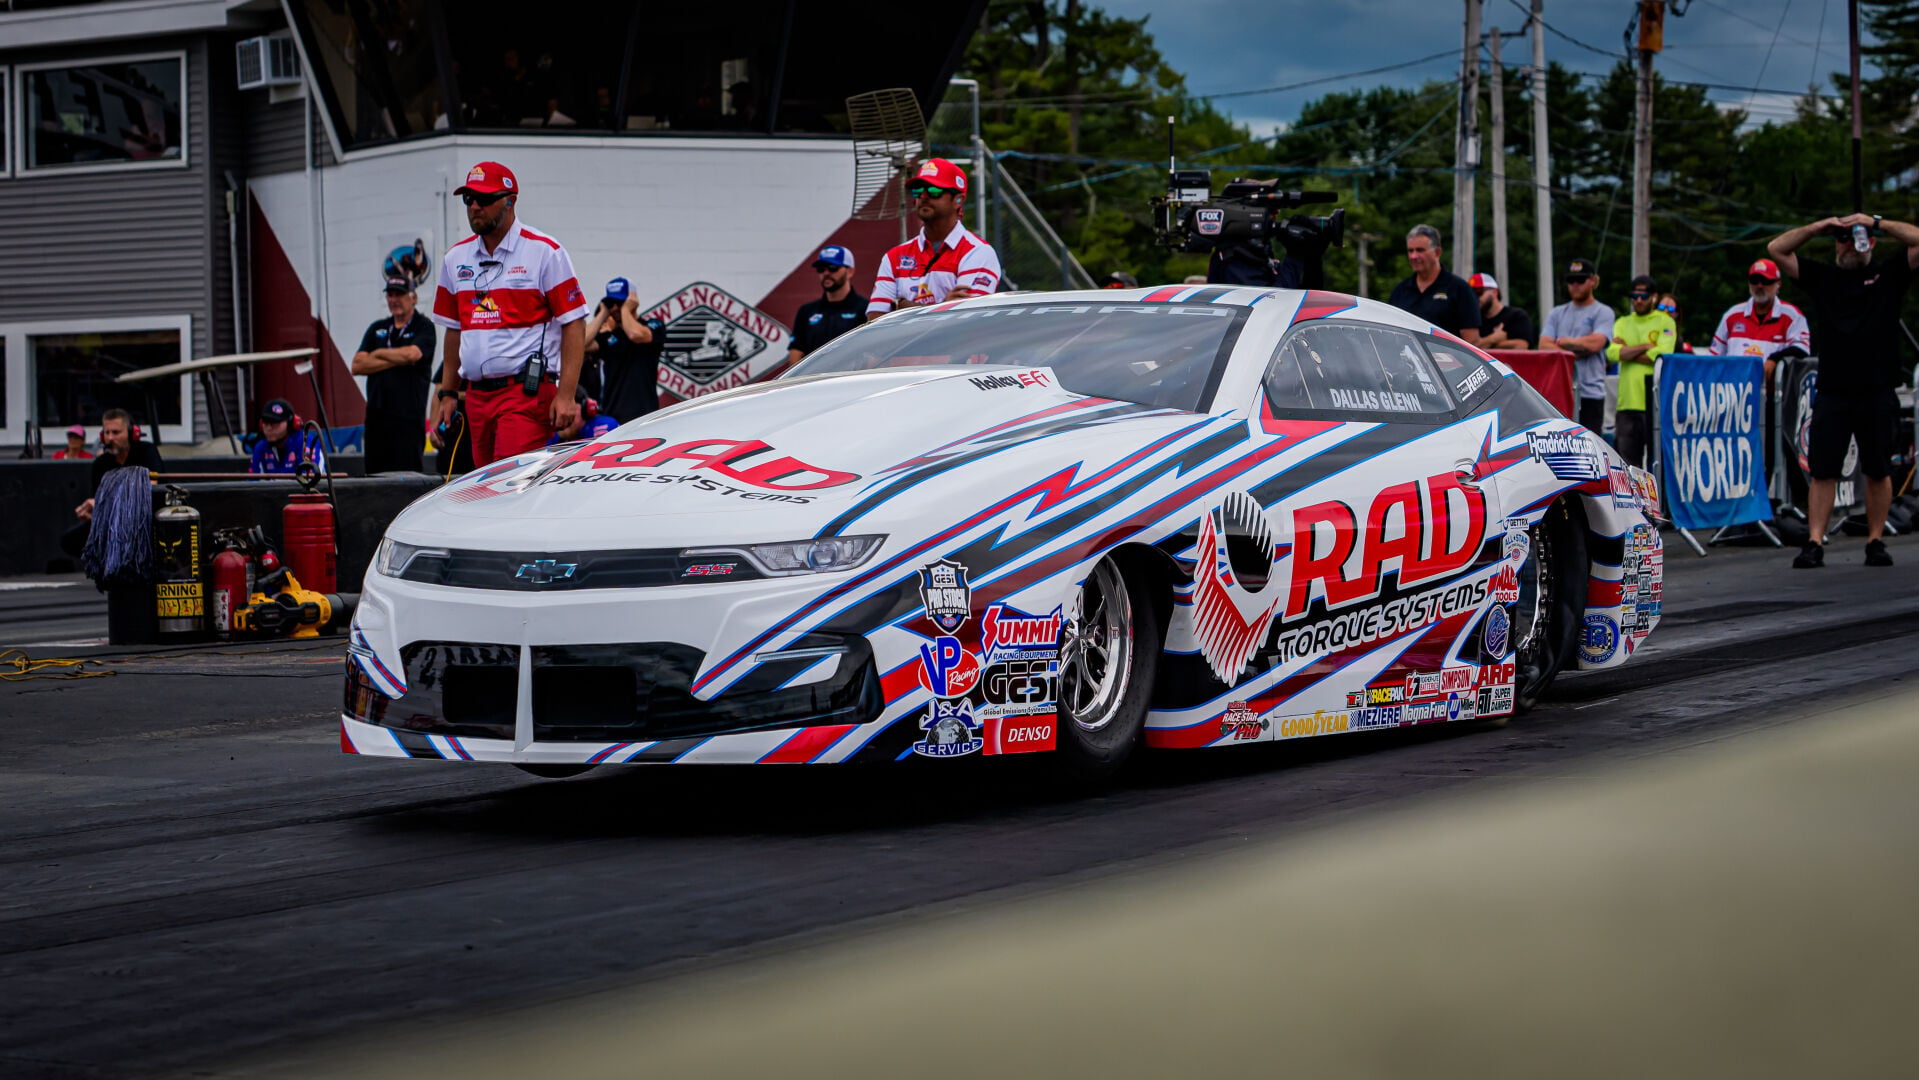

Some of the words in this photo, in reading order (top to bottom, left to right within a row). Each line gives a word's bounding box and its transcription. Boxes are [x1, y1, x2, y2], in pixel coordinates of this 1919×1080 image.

[1201, 212, 1218, 221] FOX
[676, 287, 781, 343] ENGLAND
[968, 374, 1022, 392] Holley
[1420, 383, 1437, 394] PRO
[1329, 388, 1380, 409] DALLAS
[1380, 392, 1422, 411] GLENN
[1672, 381, 1752, 435] CAMPING
[559, 438, 862, 491] RAD
[1672, 437, 1752, 503] WORLD
[539, 472, 653, 486] ORQUE
[650, 474, 820, 504] SYSTEMS
[1282, 471, 1487, 618] RAD
[1496, 565, 1517, 591] MAC
[927, 588, 944, 609] PRO
[943, 588, 967, 609] STOCK
[1496, 592, 1517, 601] TOOLS
[982, 607, 1061, 652] SUMMIT
[920, 636, 962, 696] VP
[994, 652, 1018, 660] RACING
[1020, 651, 1058, 659] EQUIPMENT
[949, 667, 980, 689] Racing
[1441, 669, 1471, 690] SIMPSON
[1477, 664, 1514, 686] ARP
[1372, 686, 1404, 703] RACEPAK
[1494, 688, 1511, 699] SUPER
[919, 698, 977, 729] J&A
[984, 707, 1001, 716] Global
[1003, 706, 1026, 715] Emissions
[1400, 701, 1447, 725] MagnaFuel
[1491, 700, 1511, 711] DAMPER
[1223, 713, 1241, 722] RACE
[1242, 712, 1258, 722] STAR
[1357, 707, 1400, 727] MEZIERE
[1008, 726, 1050, 743] DENSO
[917, 741, 978, 755] SERVICE
